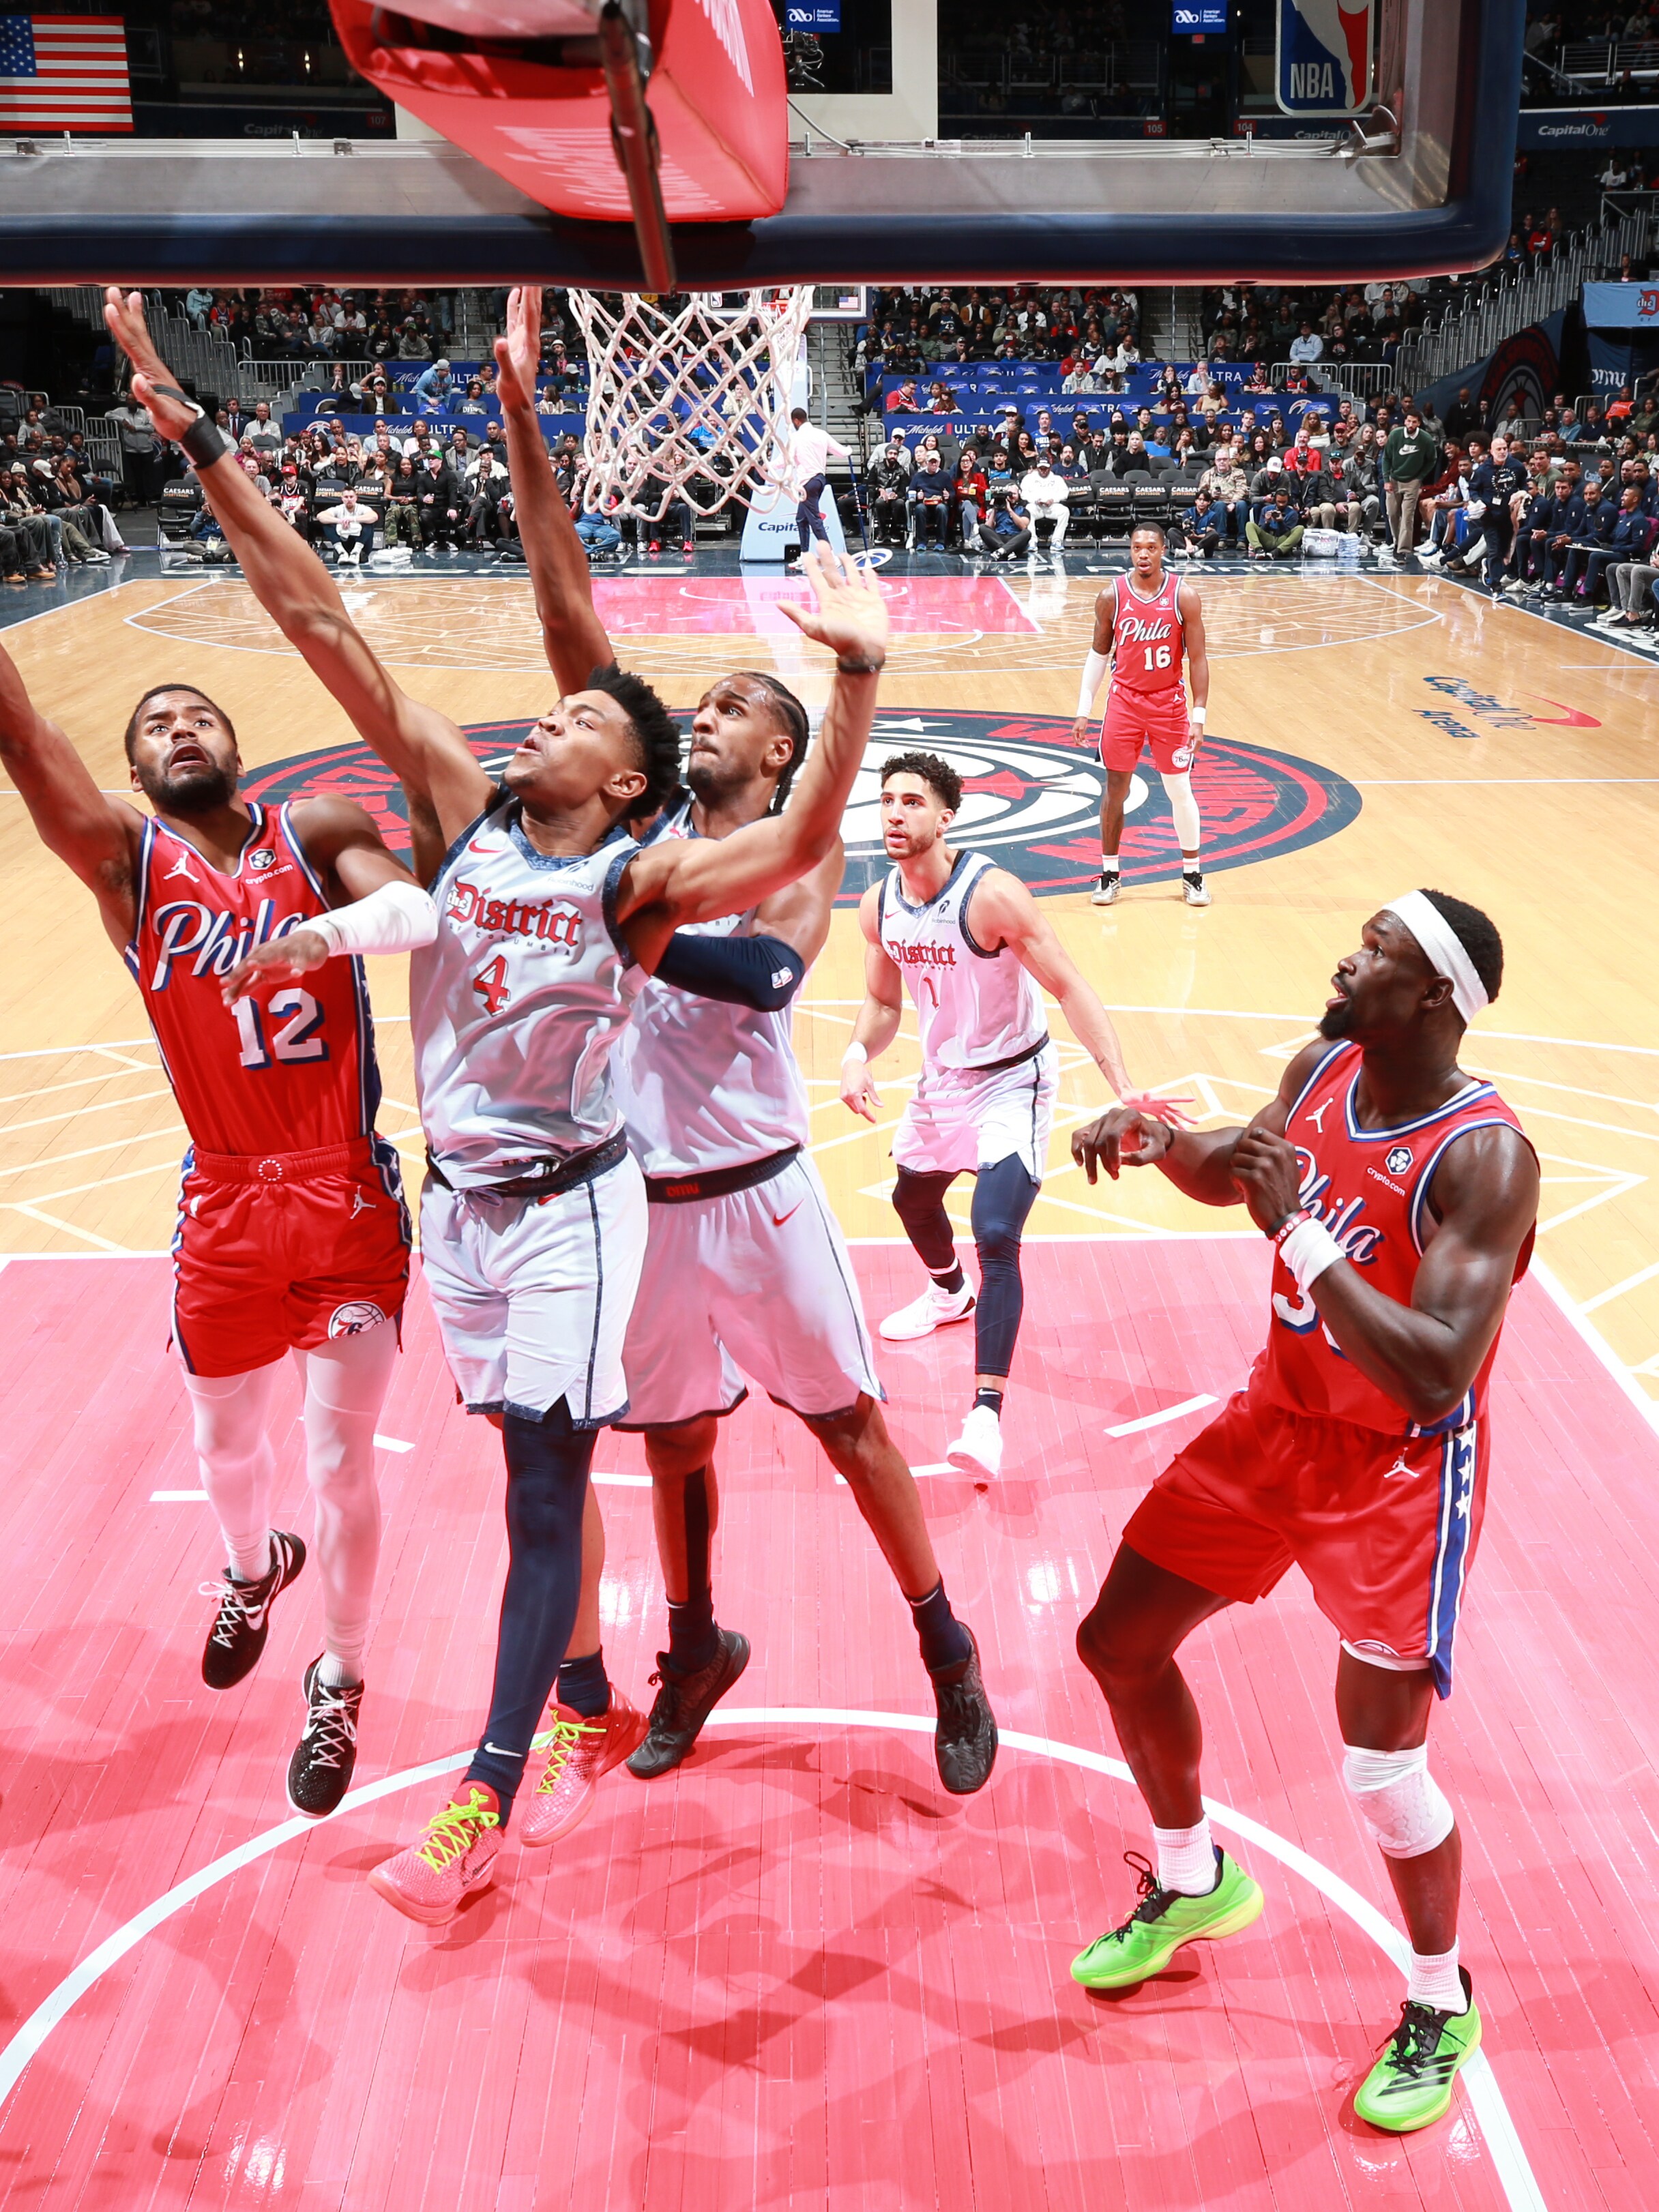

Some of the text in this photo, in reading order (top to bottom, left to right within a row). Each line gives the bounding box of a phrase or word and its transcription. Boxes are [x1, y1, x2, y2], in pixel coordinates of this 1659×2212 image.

[1290, 63, 1334, 99] NBA
[370, 116, 386, 126] 107
[1147, 124, 1163, 134] 105
[1237, 123, 1253, 132] 104
[905, 424, 994, 434] Michelob ULTA
[1118, 617, 1172, 647] Phila
[1143, 645, 1172, 671] 16
[1411, 709, 1480, 738] Arena
[245, 864, 293, 885] crypto.com
[445, 877, 583, 947] District
[446, 889, 468, 909] the
[886, 939, 957, 967] District
[473, 954, 511, 1017] 4
[923, 976, 940, 1010] 1
[231, 988, 329, 1070] 12
[1366, 1166, 1406, 1197] crypto.com
